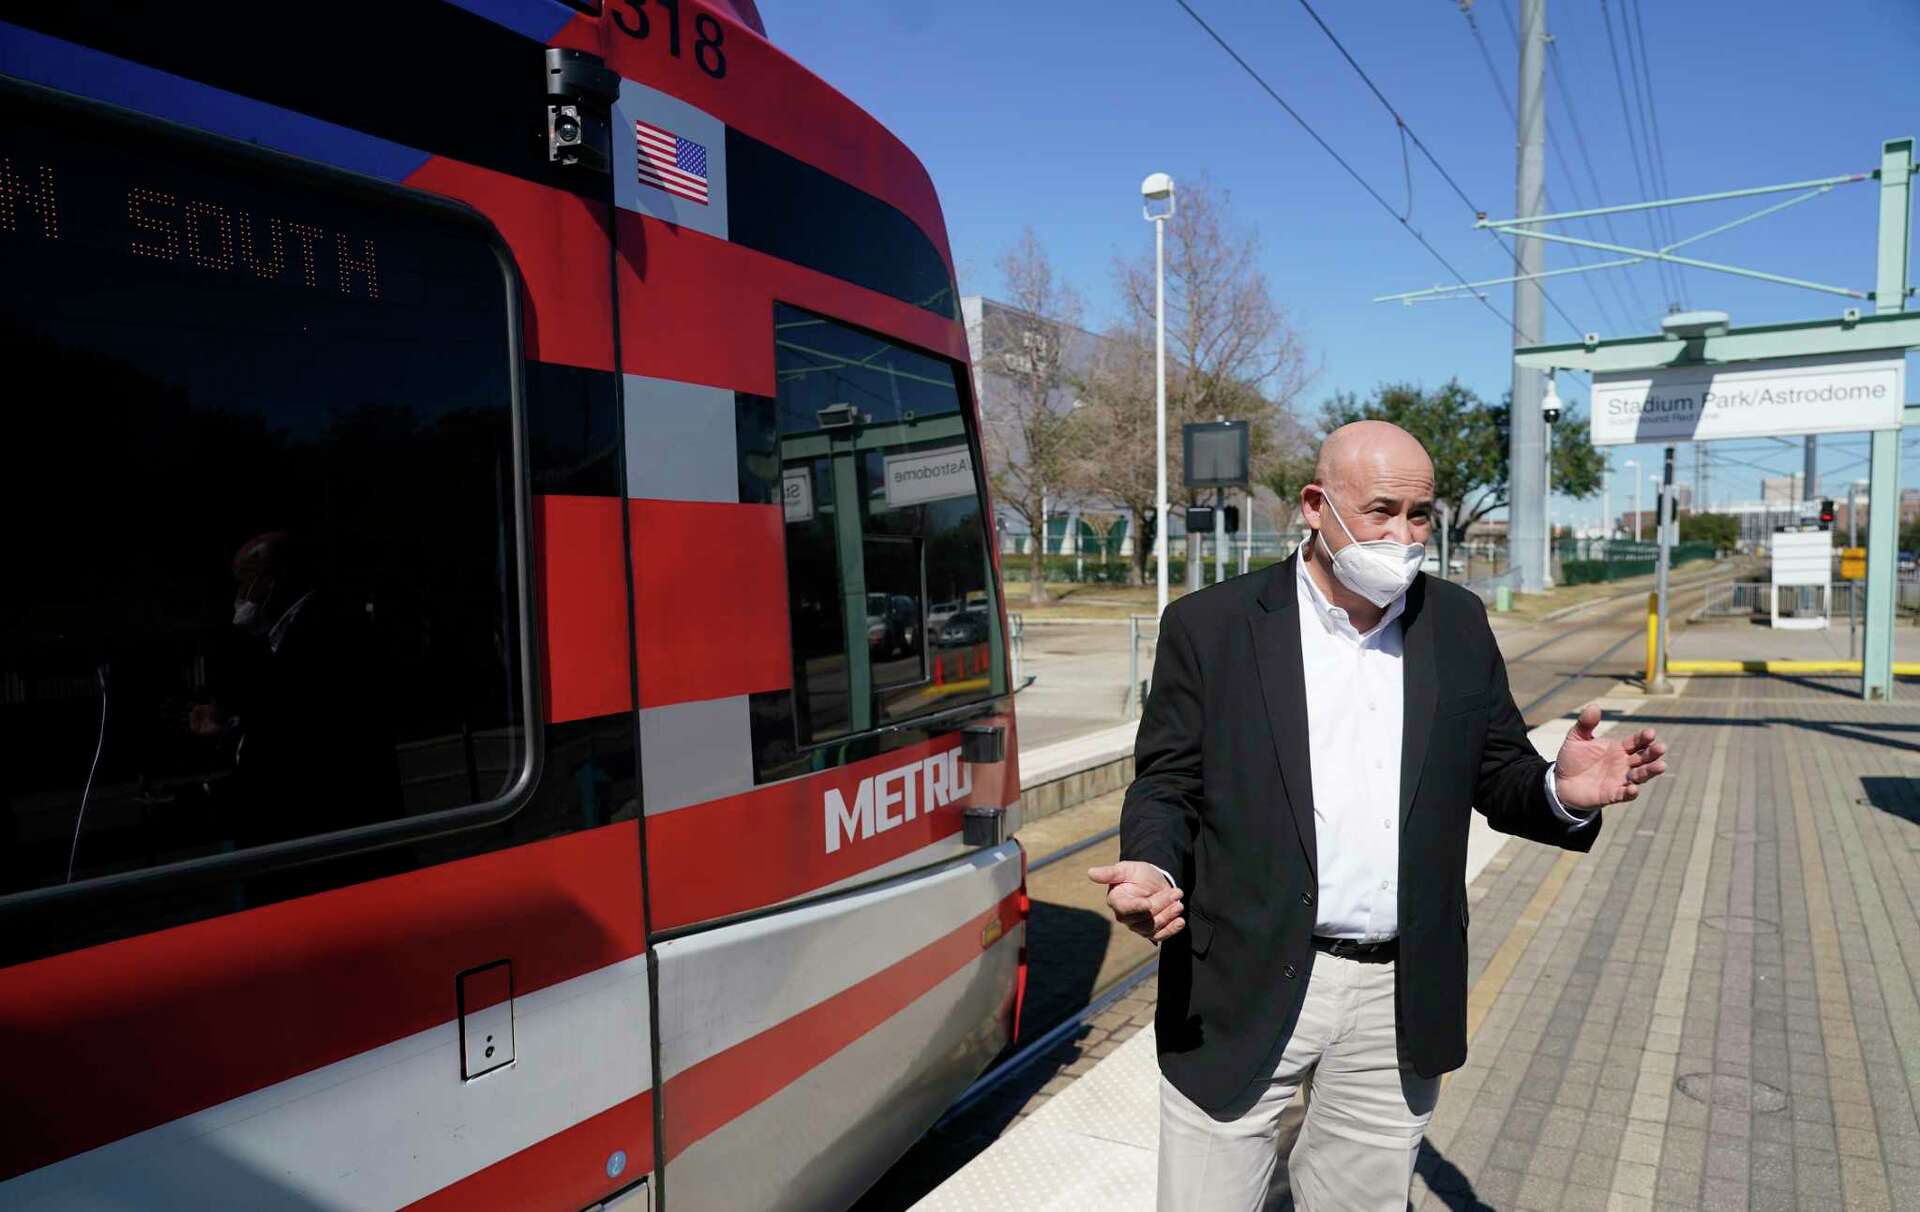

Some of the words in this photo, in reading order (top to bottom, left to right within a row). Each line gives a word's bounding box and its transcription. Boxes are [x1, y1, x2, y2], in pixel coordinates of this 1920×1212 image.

[611, 0, 727, 79] 318
[127, 187, 379, 299] SOUTH
[1607, 396, 1694, 415] Stadium
[1701, 384, 1887, 409] Park/Astrodome
[824, 747, 973, 854] METRO
